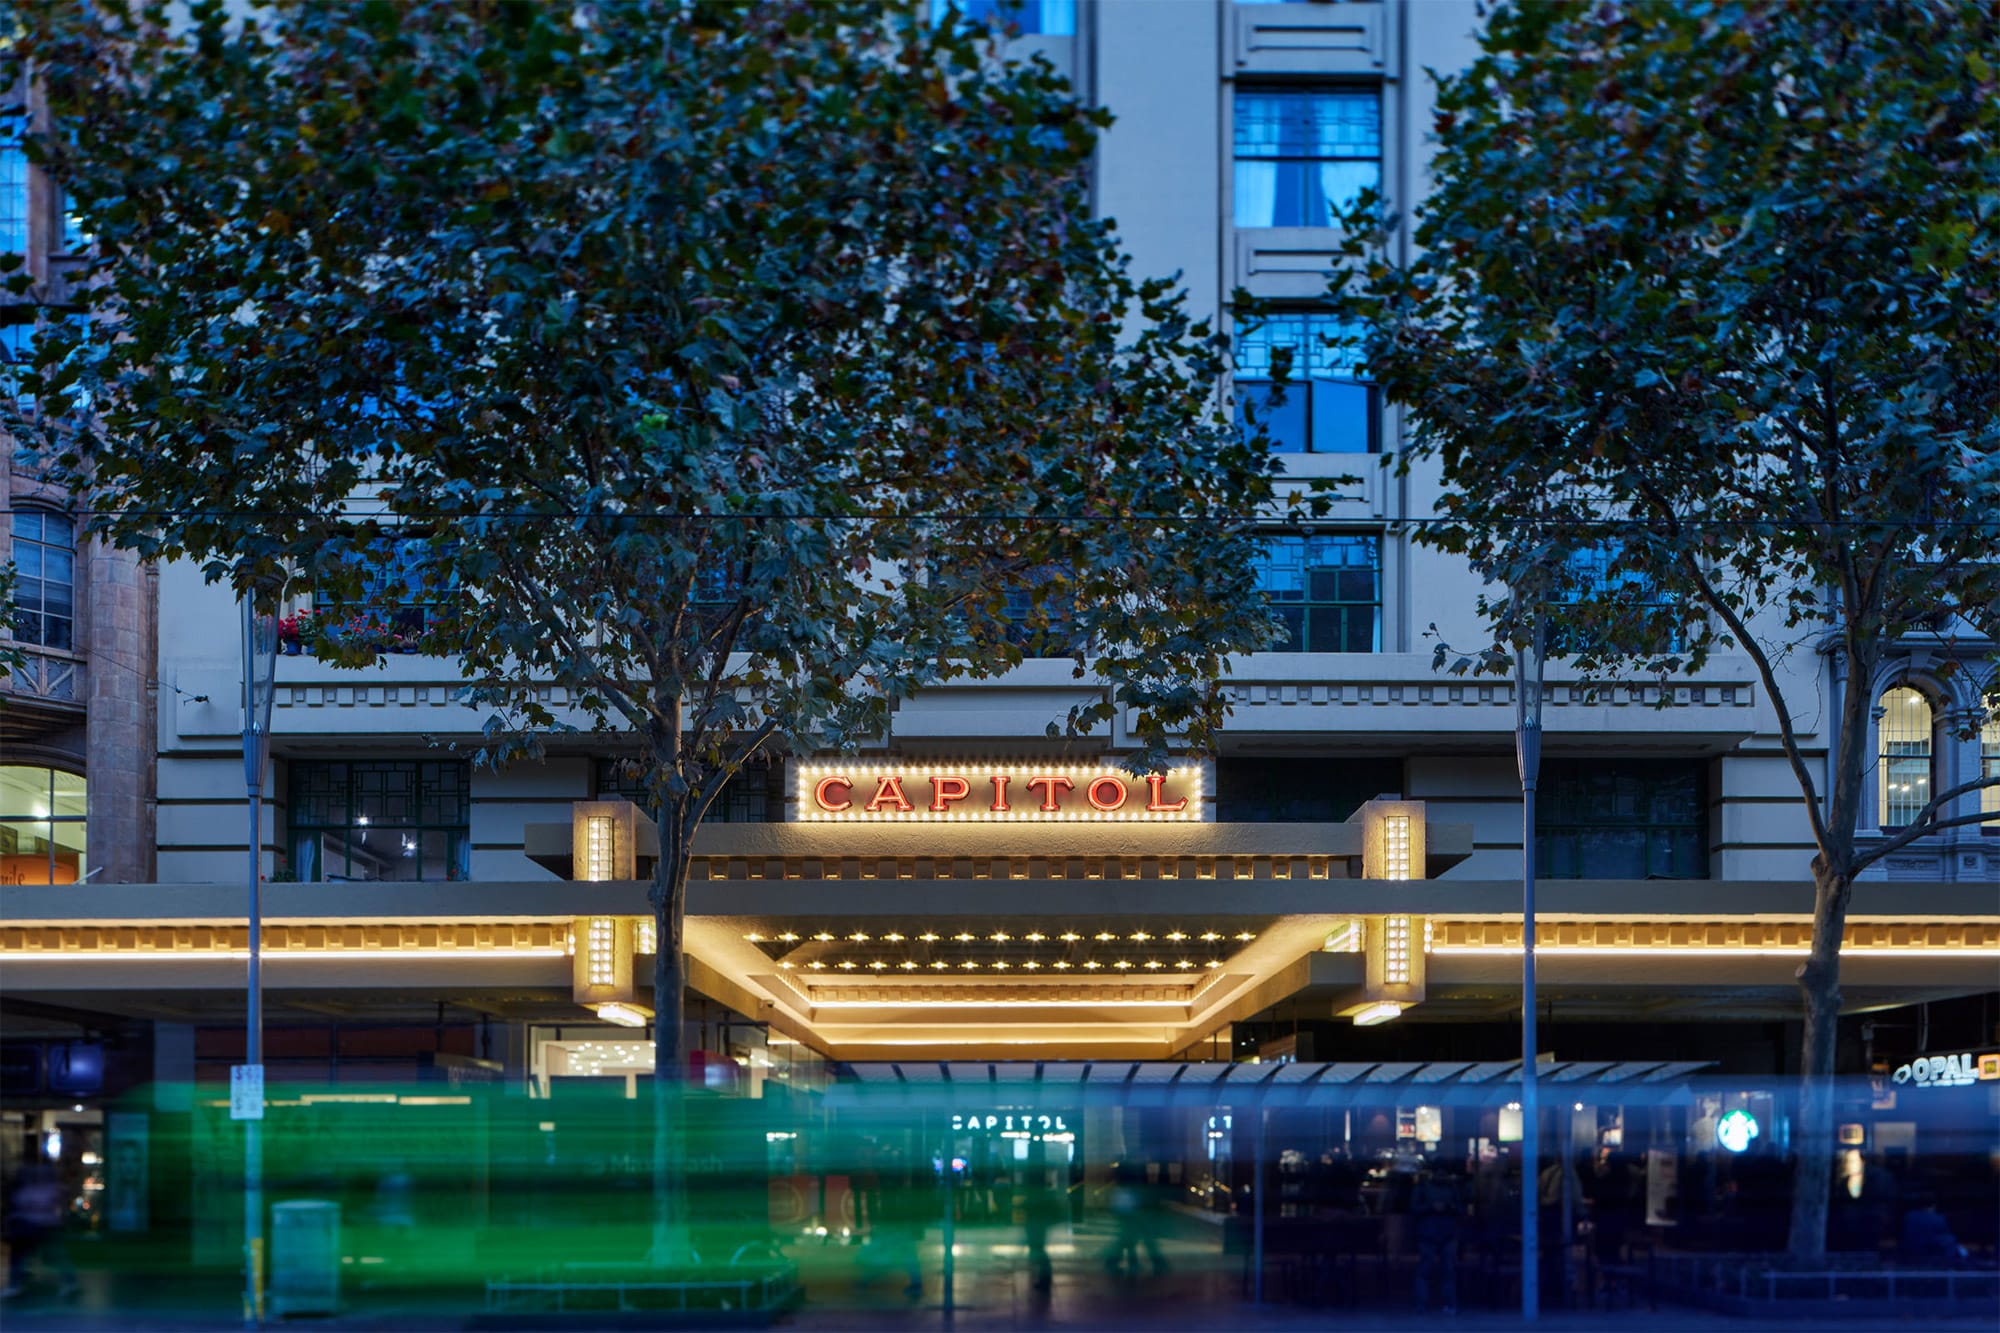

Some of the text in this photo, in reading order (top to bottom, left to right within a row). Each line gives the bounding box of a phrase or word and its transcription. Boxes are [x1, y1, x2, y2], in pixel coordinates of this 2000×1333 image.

[814, 775, 1189, 812] CAPITOL
[1912, 1053, 1979, 1082] OPAL
[952, 1115, 1067, 1130] CAPITOL
